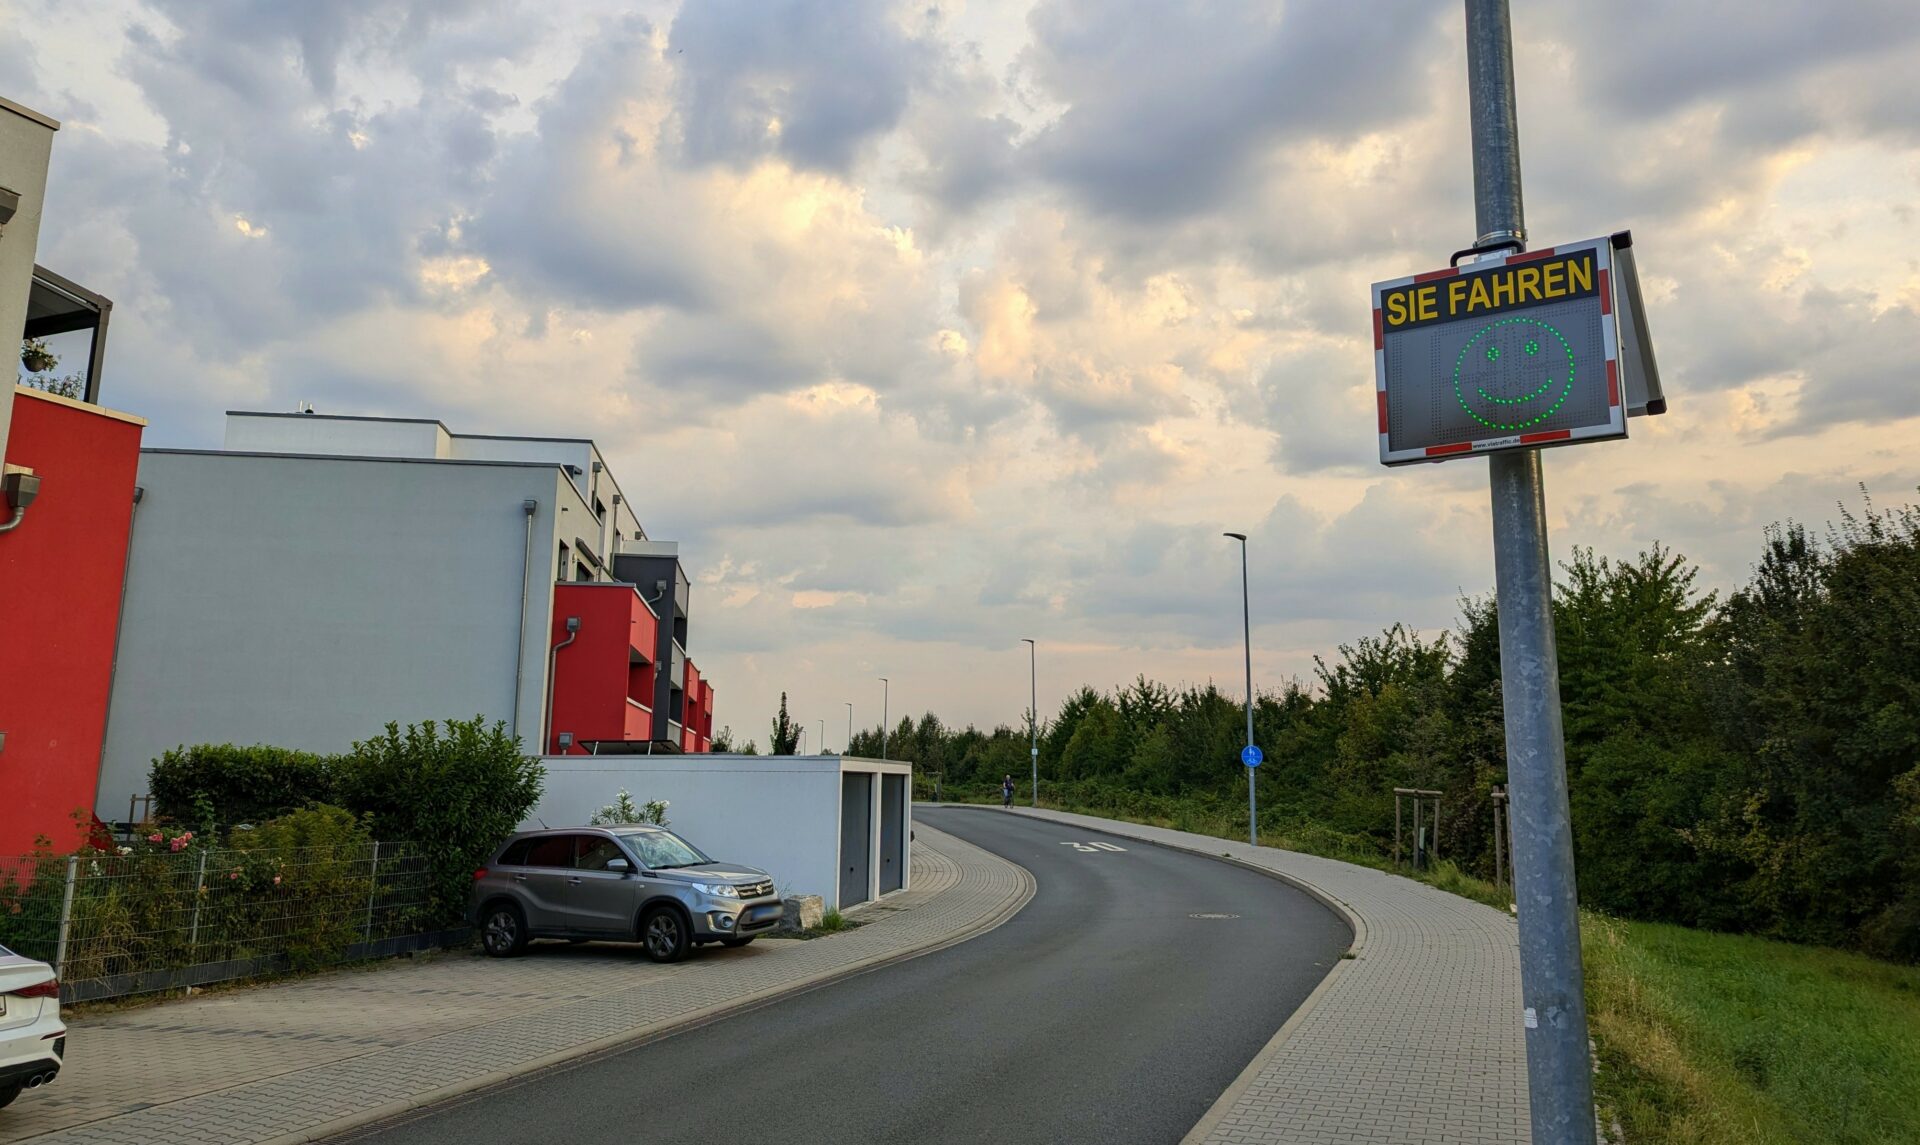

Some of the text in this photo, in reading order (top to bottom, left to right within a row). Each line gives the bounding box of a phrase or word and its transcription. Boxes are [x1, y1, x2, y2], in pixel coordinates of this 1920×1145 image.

[1387, 256, 1592, 326] SIE FAHREN
[1059, 841, 1128, 852] 30
